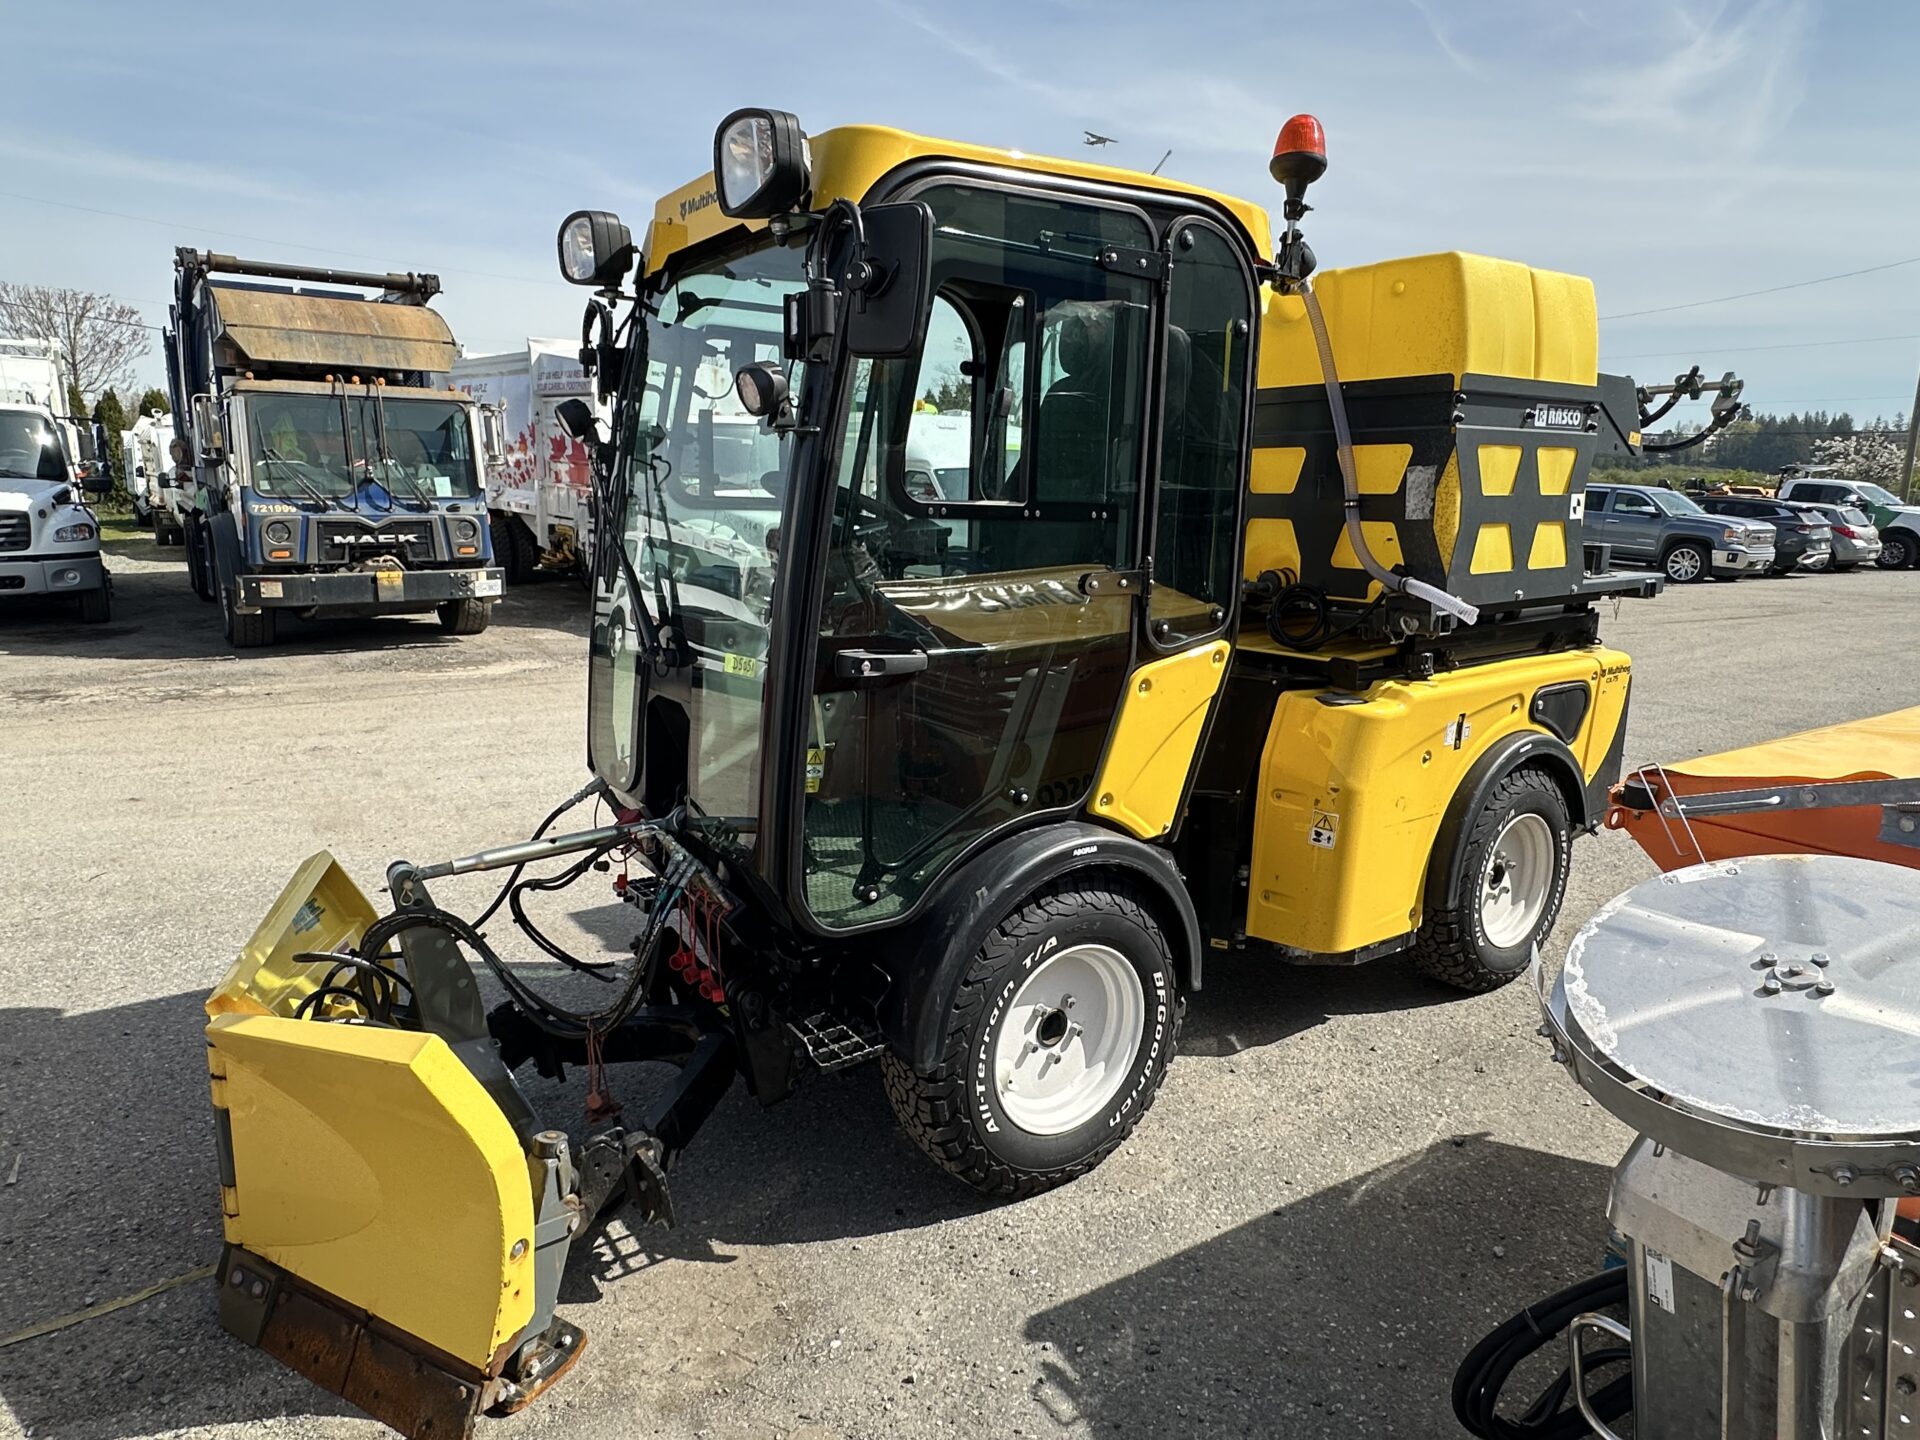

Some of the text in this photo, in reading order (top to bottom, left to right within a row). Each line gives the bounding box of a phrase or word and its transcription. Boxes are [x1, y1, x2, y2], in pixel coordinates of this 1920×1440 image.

[687, 190, 718, 215] Multiho
[1547, 407, 1581, 426] RASCO
[333, 534, 419, 544] MACK
[976, 935, 1058, 1133] All-Terrain T/A
[1108, 971, 1168, 1128] BFGoodrich
